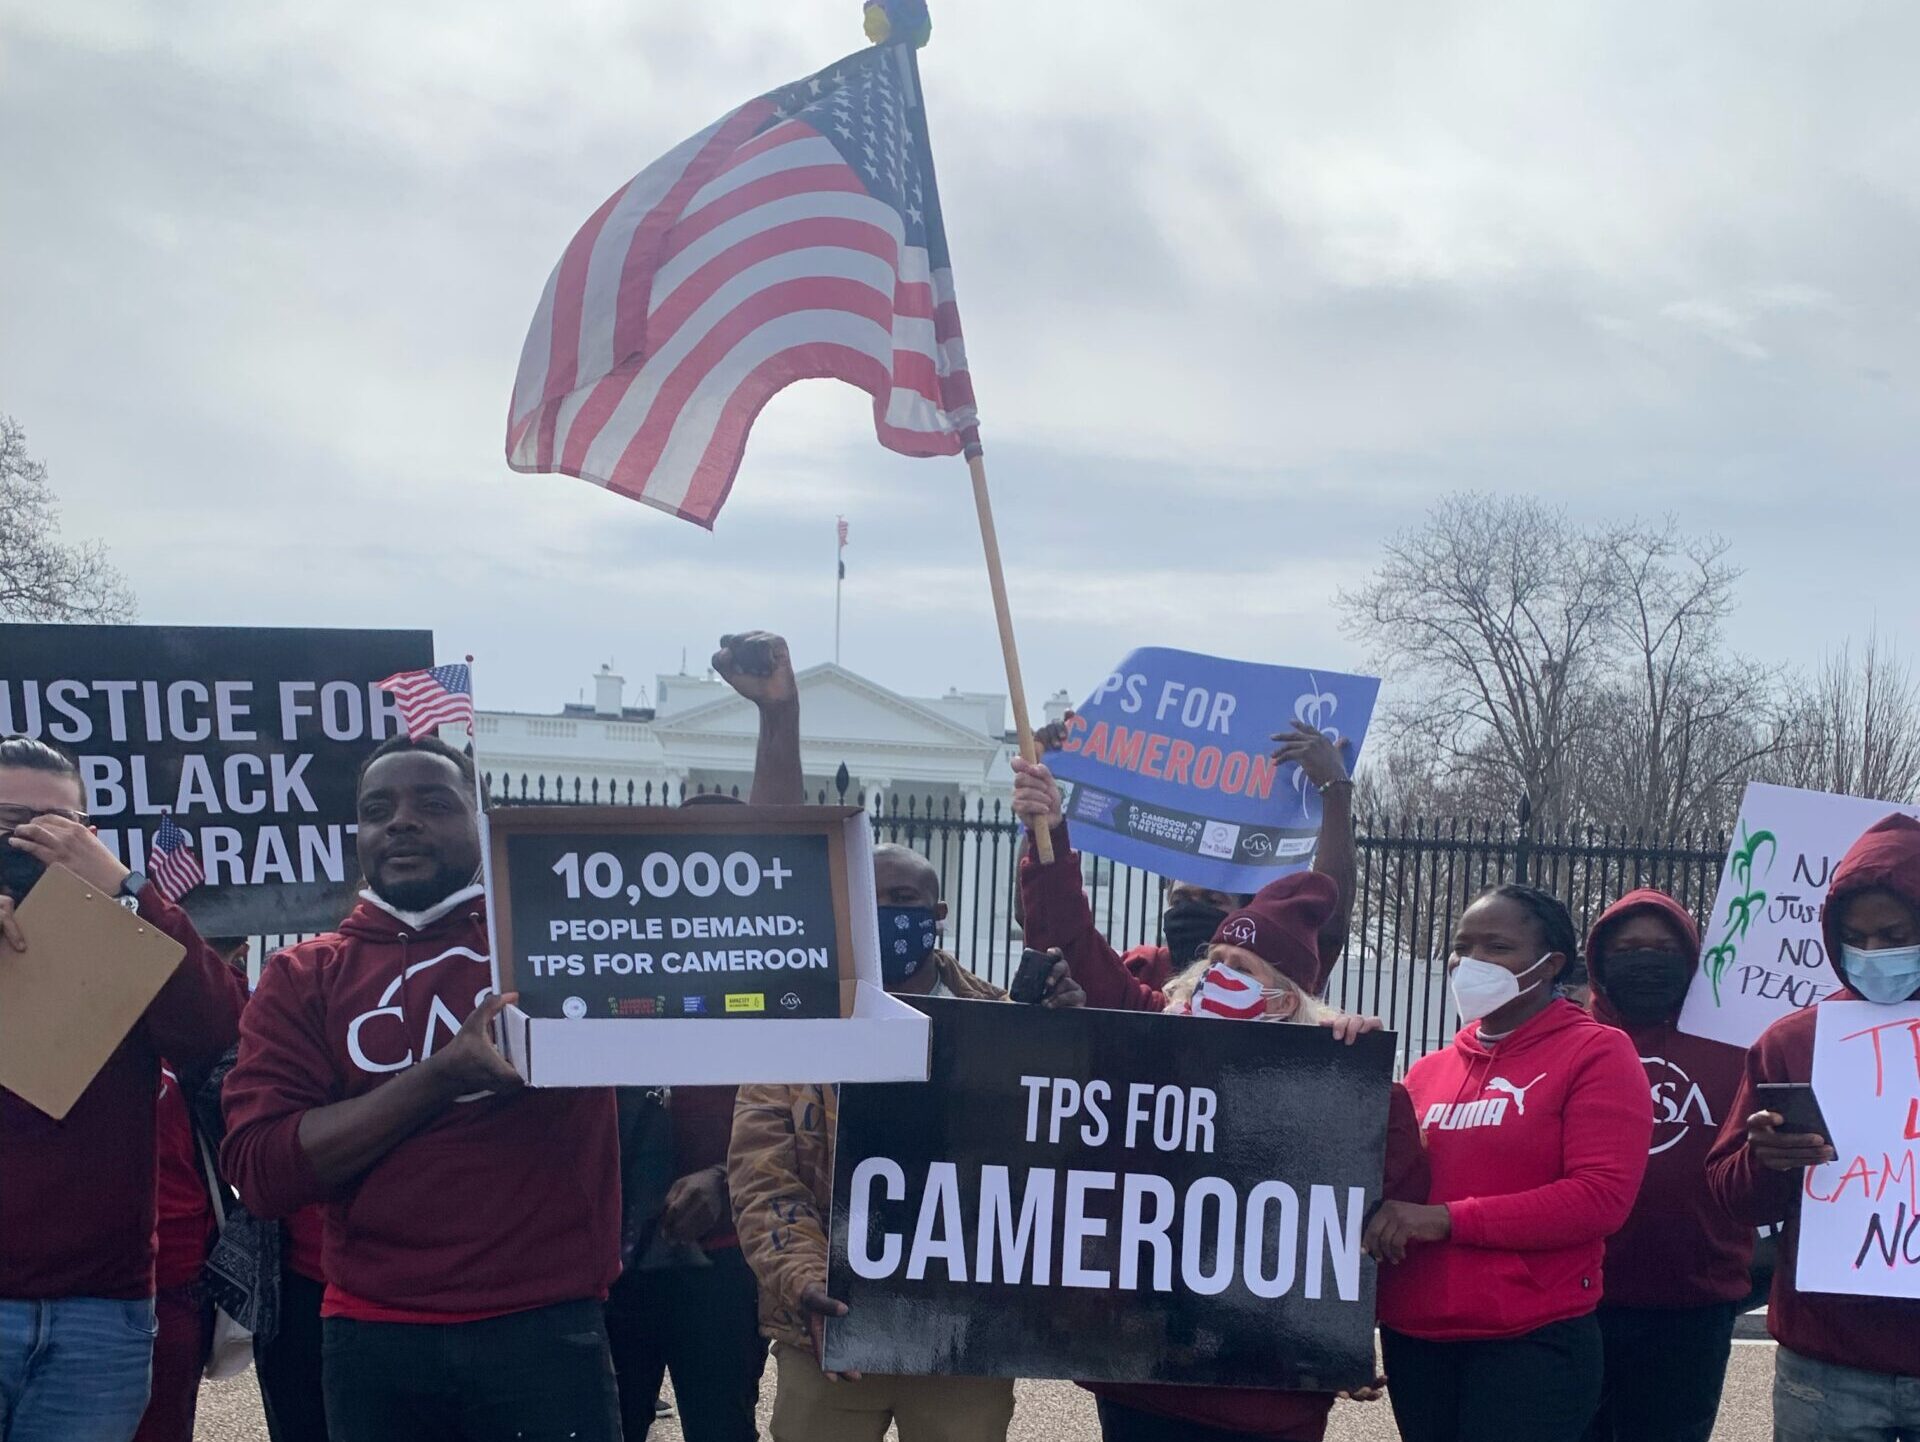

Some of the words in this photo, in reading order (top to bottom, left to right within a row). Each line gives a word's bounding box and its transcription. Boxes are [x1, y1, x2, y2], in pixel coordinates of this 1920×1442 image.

[279, 681, 408, 740] FOR
[1155, 681, 1237, 735] FOR
[1062, 714, 1278, 799] CAMEROON
[78, 753, 319, 816] BLACK
[1137, 825, 1184, 843] NETWORK
[1139, 818, 1186, 835] ADVOCACY
[1141, 812, 1188, 830] CAMEROON
[552, 851, 792, 906] 10,000+
[550, 918, 663, 941] PEOPLE
[671, 915, 805, 939] DEMAND:
[1222, 922, 1257, 945] CASA
[528, 955, 586, 977] TPS
[593, 952, 653, 975] FOR
[661, 948, 829, 974] CAMEROON
[1777, 938, 1824, 968] NO
[1738, 965, 1834, 1008] PEACE
[1020, 1075, 1111, 1147] TPS
[1125, 1083, 1218, 1153] FOR
[1422, 1098, 1509, 1130] PUMA
[847, 1156, 1366, 1302] CAMEROON
